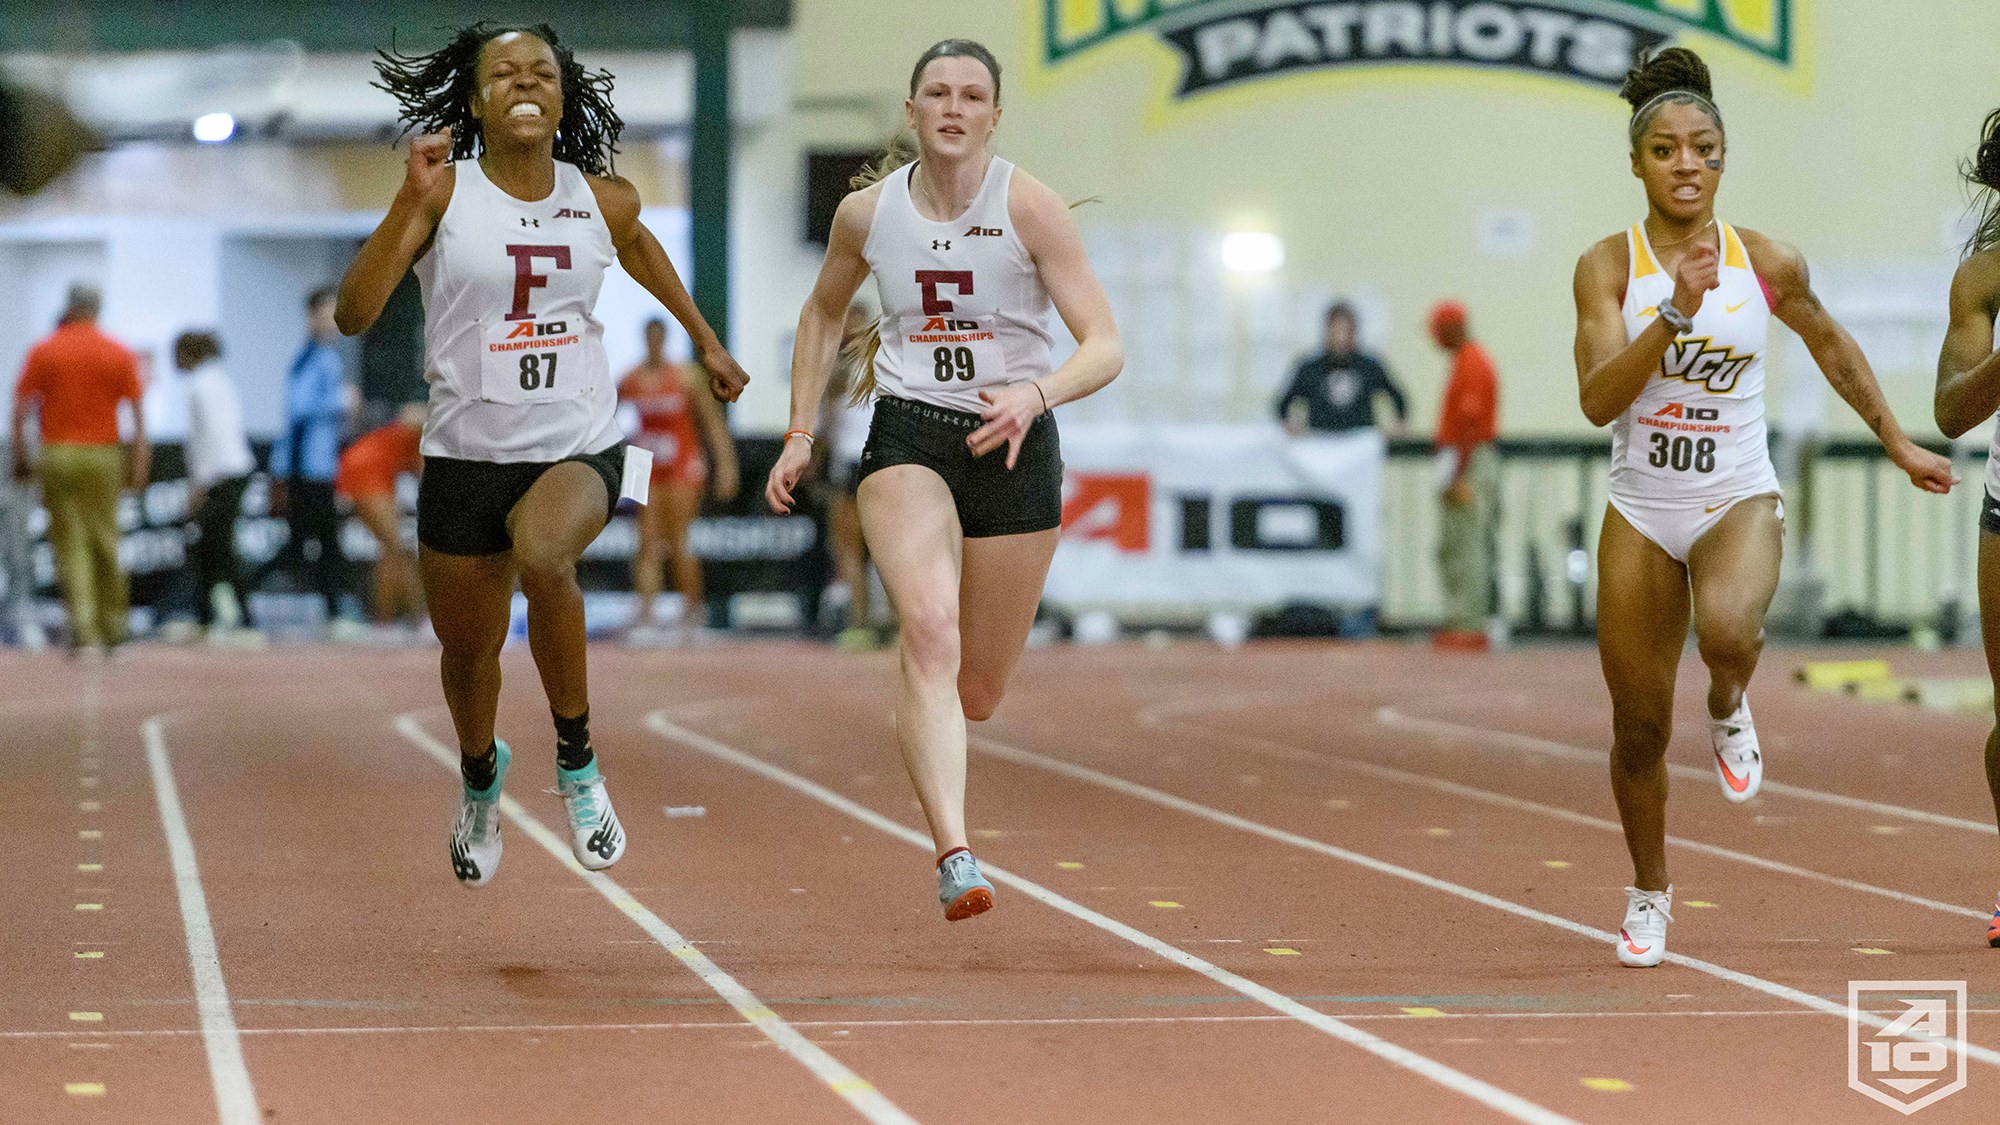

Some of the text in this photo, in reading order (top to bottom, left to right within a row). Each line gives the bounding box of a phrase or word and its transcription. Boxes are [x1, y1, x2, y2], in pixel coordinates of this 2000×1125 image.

[1200, 3, 1632, 78] PATRIOTS
[553, 208, 591, 219] A10
[964, 226, 1003, 237] A10
[505, 244, 572, 321] F
[507, 321, 567, 338] A10
[921, 317, 979, 332] A10
[489, 335, 579, 352] CHAMPIONSHIPS
[909, 332, 994, 343] CHAMPIONSHIPS
[519, 352, 557, 391] 87
[933, 346, 975, 382] 89
[1661, 337, 1753, 394] VCU
[1653, 403, 1719, 421] A10
[1637, 416, 1731, 434] CHAMPIONSHIPS
[1648, 432, 1716, 474] 308
